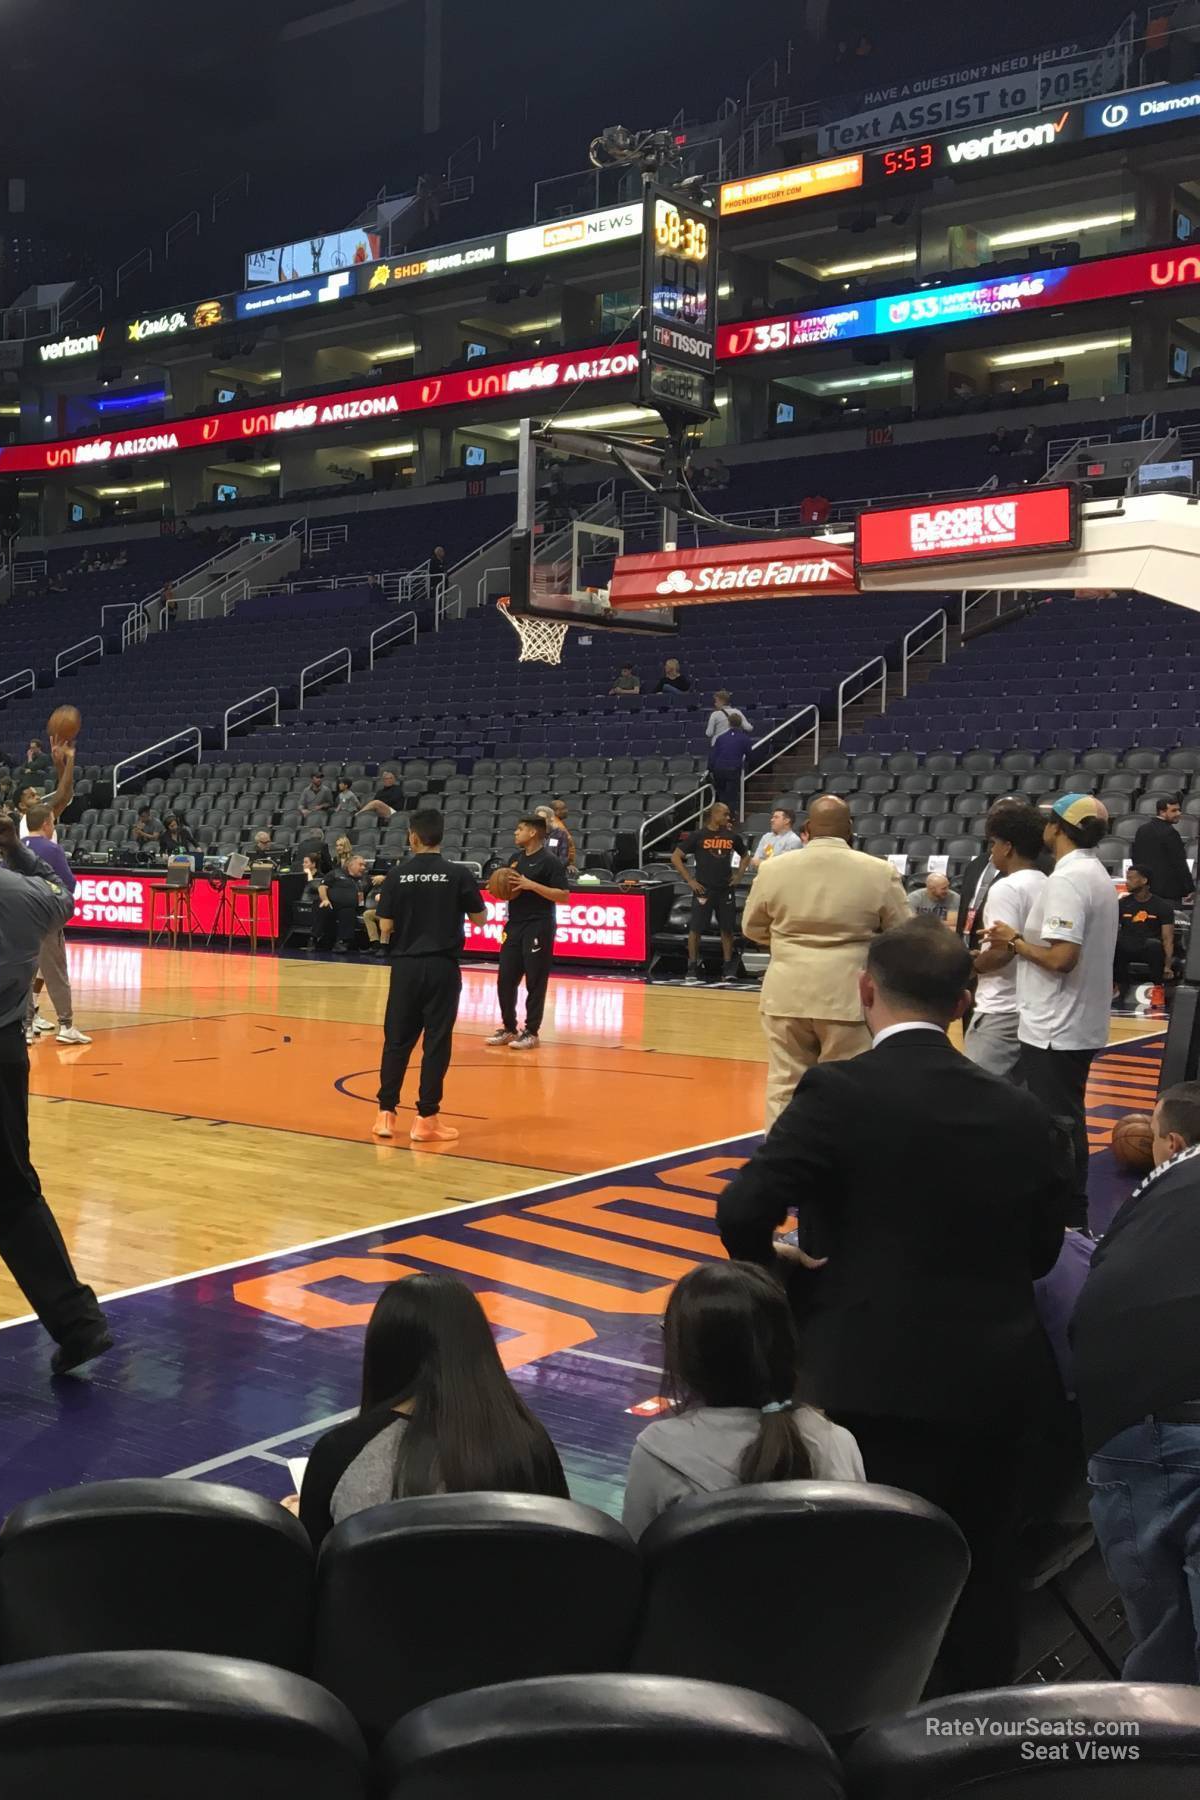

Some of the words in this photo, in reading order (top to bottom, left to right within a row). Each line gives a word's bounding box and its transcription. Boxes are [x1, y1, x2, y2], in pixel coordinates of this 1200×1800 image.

[864, 87, 897, 104] HAVE
[901, 85, 910, 97] A
[912, 65, 989, 93] QUESTION?
[991, 56, 1028, 75] NEED
[1032, 44, 1078, 64] HELP?
[825, 119, 880, 147] Text
[889, 91, 990, 133] ASSIST
[999, 87, 1026, 108] to
[948, 120, 1054, 164] verizon
[885, 145, 932, 175] 5:53
[588, 214, 633, 234] NEWS
[41, 333, 98, 361] verizon
[671, 331, 712, 359] TISSOT
[754, 324, 787, 350] 35
[564, 353, 639, 382] ARIZON
[321, 396, 398, 423] ARIZONA
[114, 433, 178, 456] ARIZONA
[468, 480, 484, 496] 101
[910, 506, 983, 530] FLOOR
[911, 521, 983, 543] DECOR
[82, 906, 143, 923] STONE
[555, 905, 626, 927] ECOR
[555, 928, 625, 946] STONE
